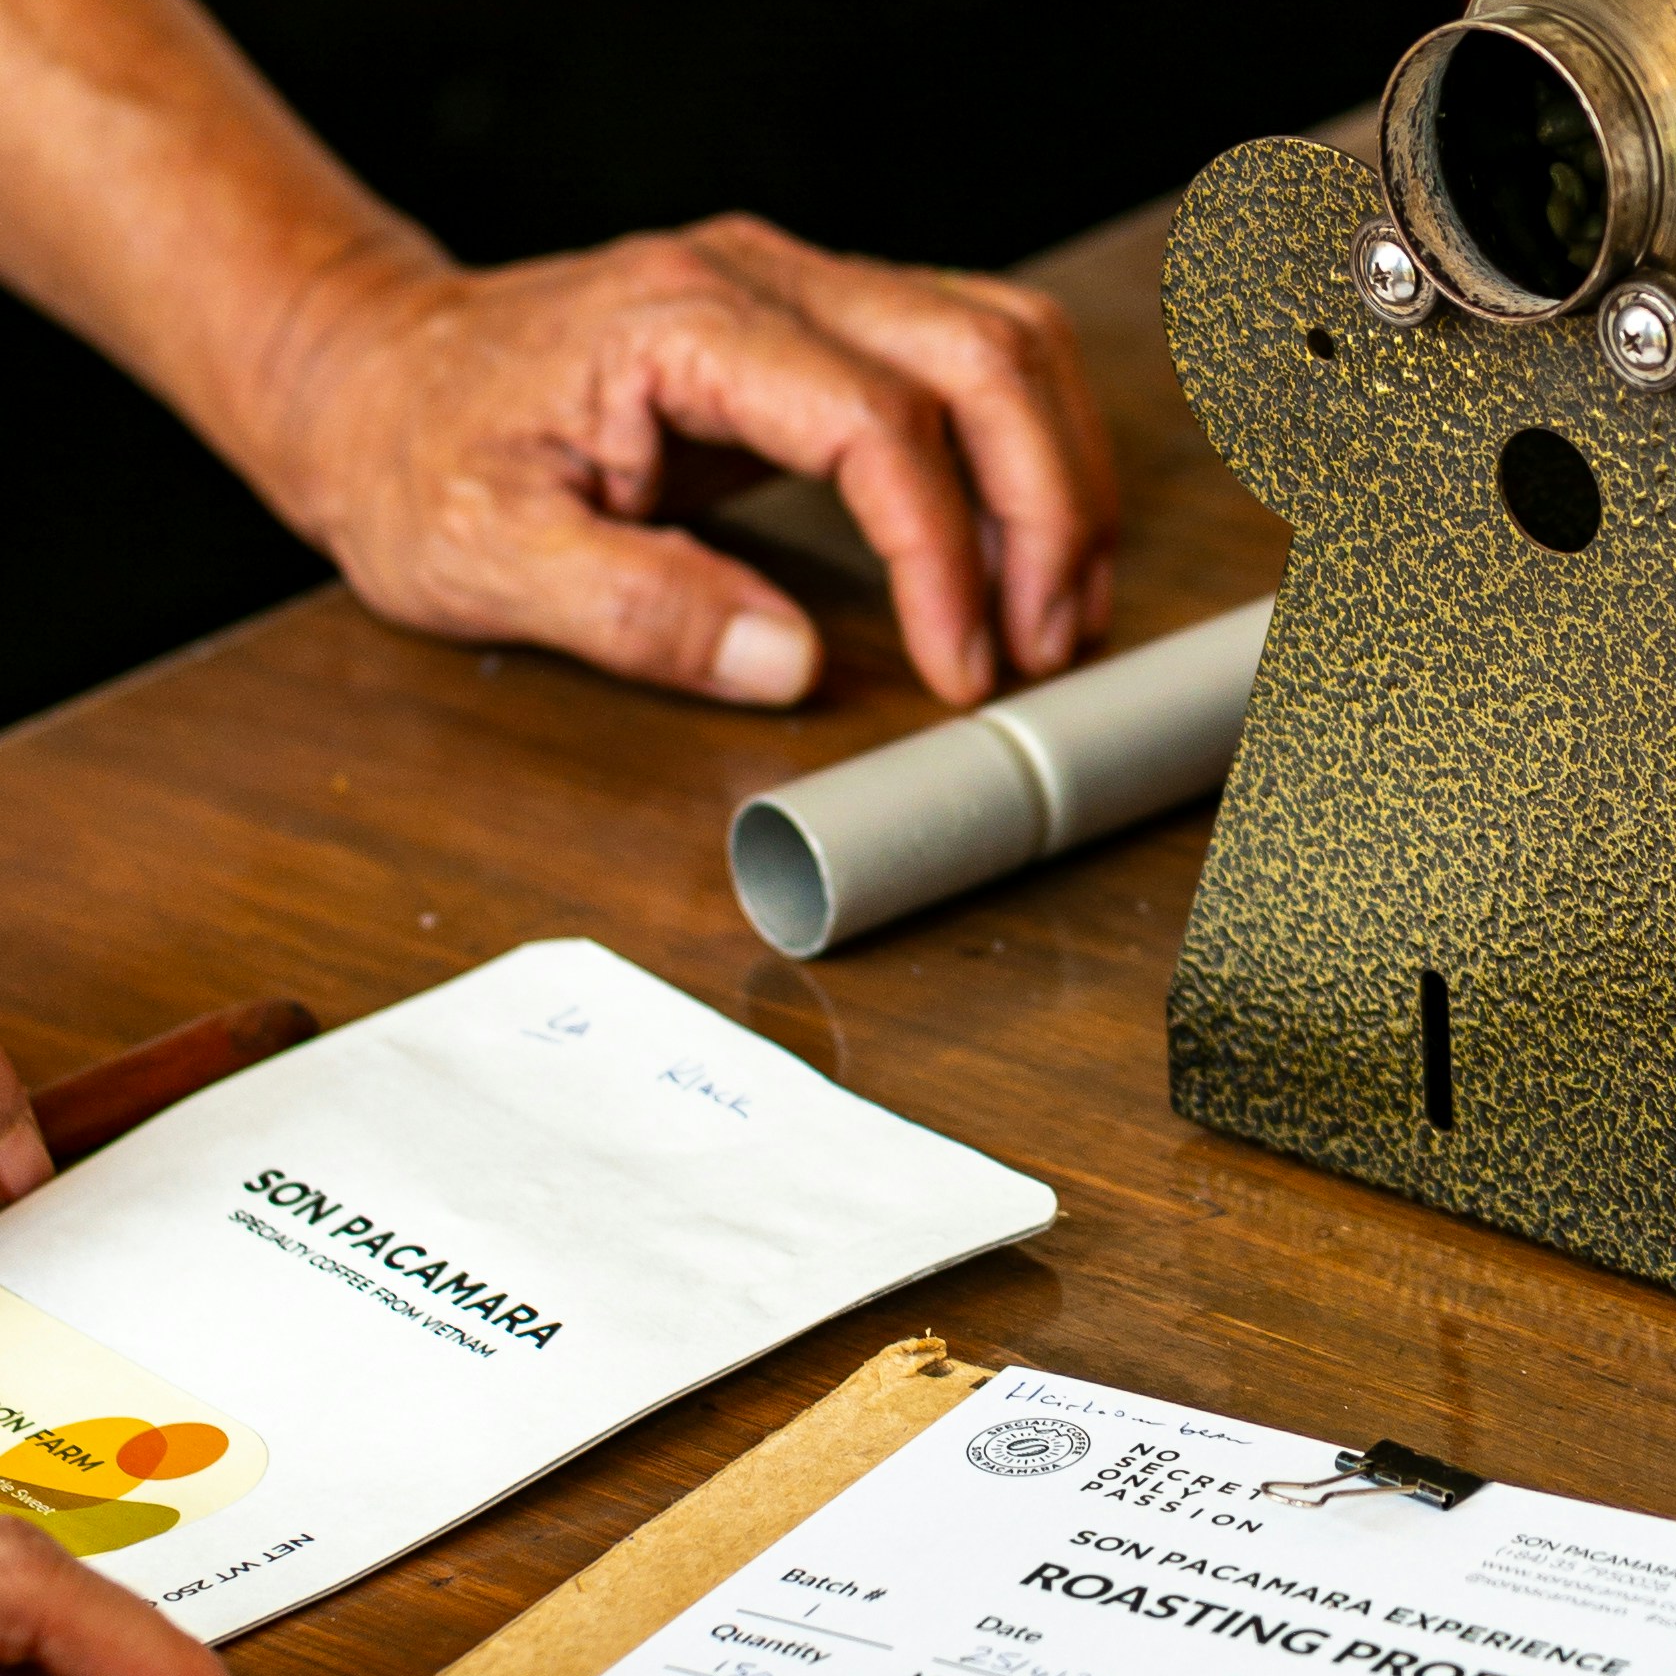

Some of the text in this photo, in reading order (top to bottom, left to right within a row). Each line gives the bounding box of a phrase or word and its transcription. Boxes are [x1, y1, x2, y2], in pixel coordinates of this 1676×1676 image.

[228, 1208, 498, 1359] SPECIALTY COFFEE FROM VIETNAM
[329, 1214, 564, 1351] PACAMARA
[25, 1429, 105, 1473] FARM
[986, 1419, 1087, 1457] SPECIALTY COFFEE
[1129, 1442, 1181, 1463] NO
[1096, 1468, 1202, 1500] ONLY
[1115, 1455, 1263, 1501] SECRET
[11, 1488, 56, 1516] Sweet
[1080, 1480, 1263, 1534] PASSION
[263, 1532, 316, 1564] NET
[215, 1560, 261, 1583] WT
[780, 1567, 888, 1603] Batch #
[1158, 1549, 1373, 1617] PACAMARA
[163, 1579, 213, 1603] 250
[1019, 1560, 1332, 1657] ROASTING
[709, 1623, 833, 1665] Quantity
[974, 1614, 1044, 1644] Date
